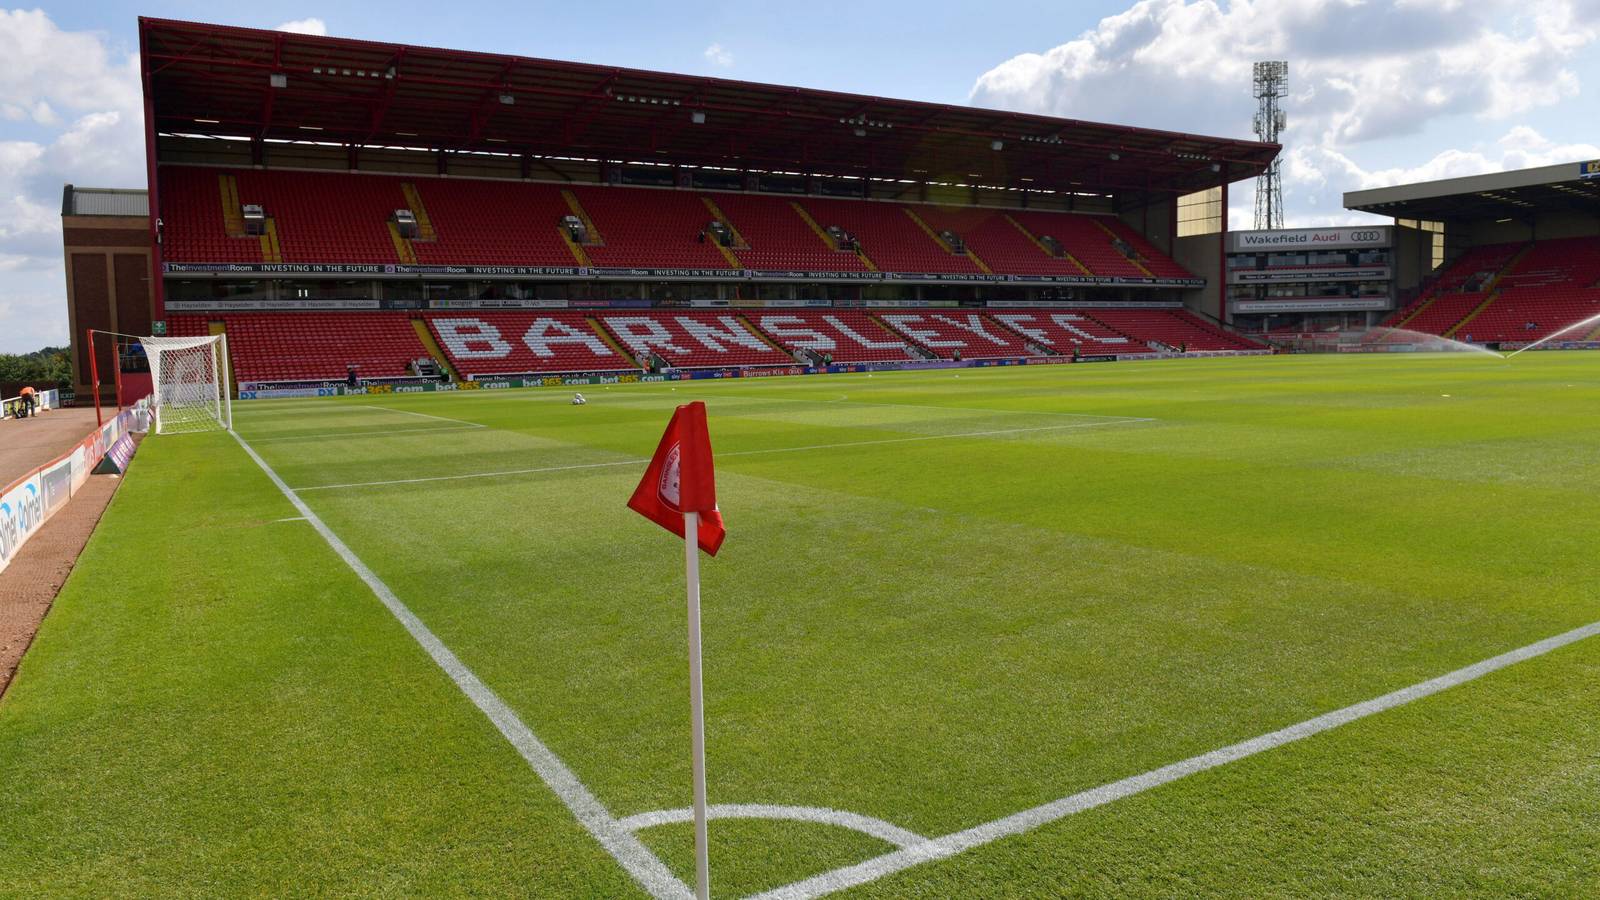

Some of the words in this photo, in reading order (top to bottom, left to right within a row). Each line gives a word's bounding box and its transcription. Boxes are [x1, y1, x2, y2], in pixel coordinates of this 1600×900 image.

[1245, 234, 1307, 245] Wakefield
[1312, 232, 1341, 242] Audi
[431, 314, 1009, 359] BARNSLEY
[743, 369, 771, 377] Burrows
[522, 377, 590, 387] bet365.com
[600, 373, 665, 384] bet365.com
[344, 384, 424, 395] bet365.com
[435, 381, 510, 391] bet365.com
[240, 391, 257, 400] DX
[319, 387, 334, 396] DX
